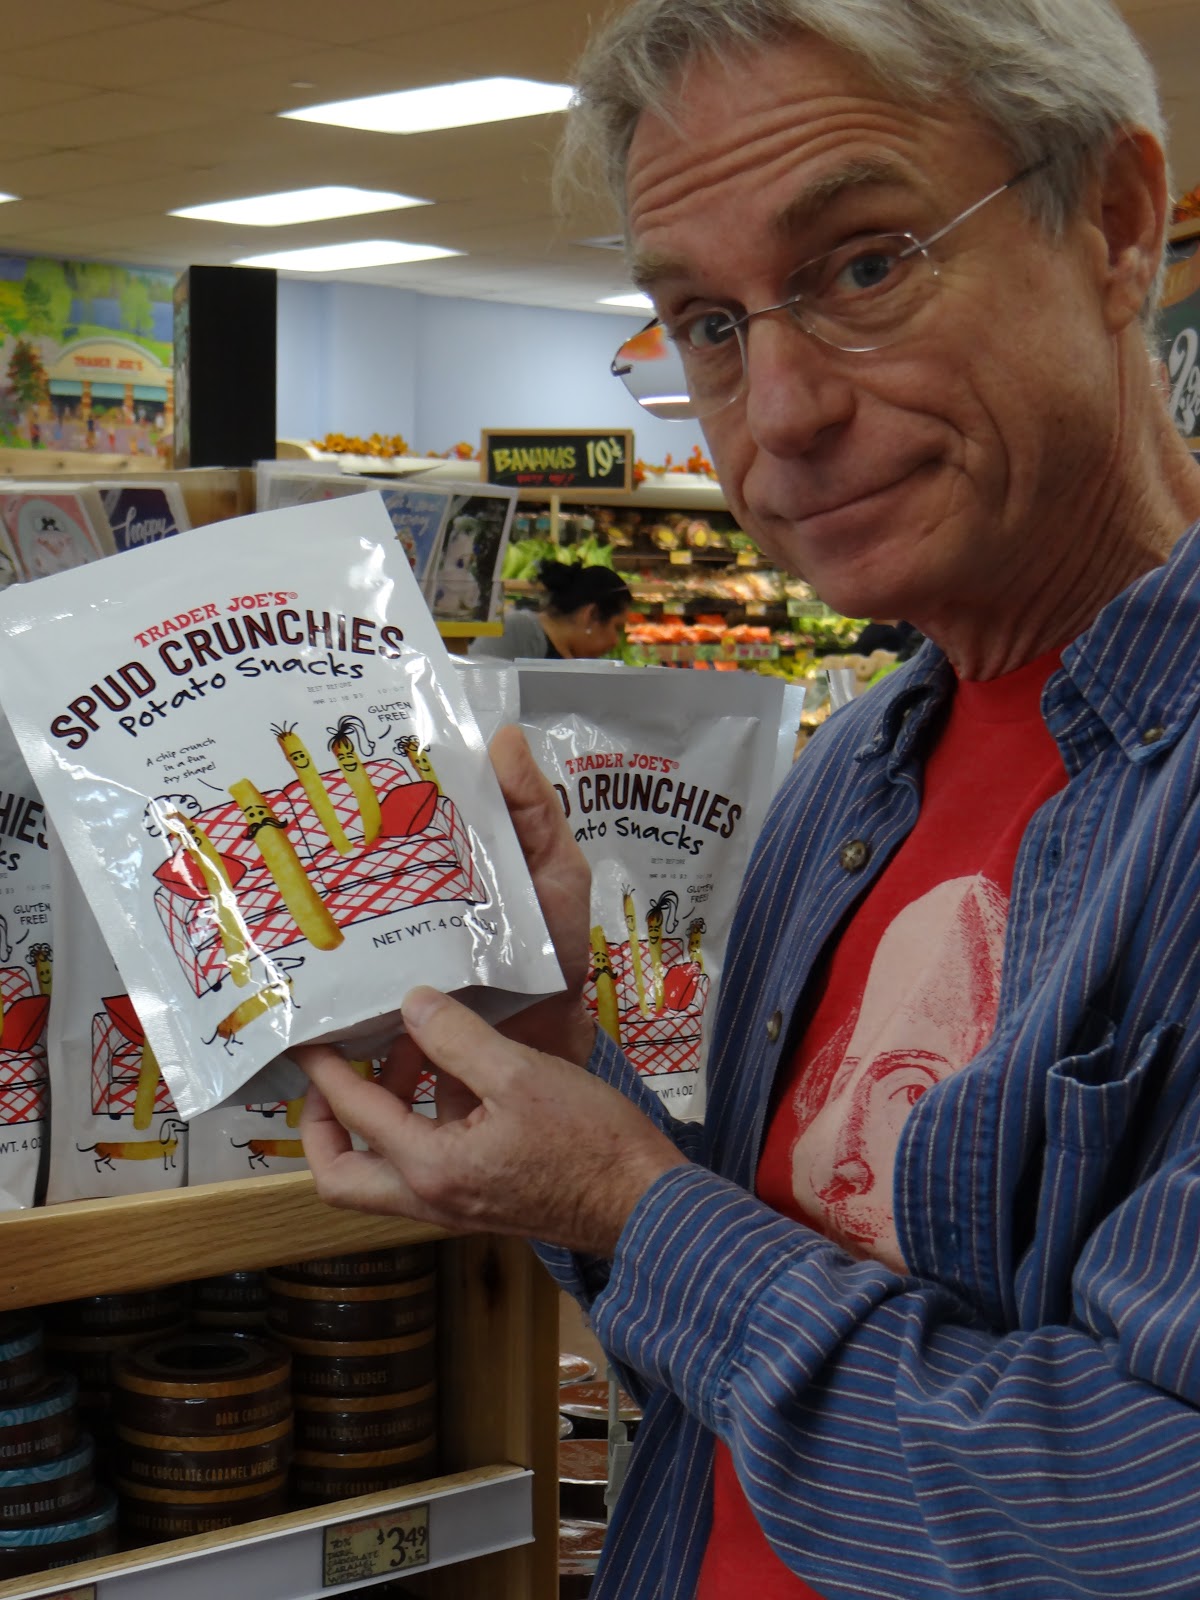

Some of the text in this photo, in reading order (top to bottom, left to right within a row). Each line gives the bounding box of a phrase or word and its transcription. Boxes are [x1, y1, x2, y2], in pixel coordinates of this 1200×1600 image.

[493, 446, 577, 472] BANANAS
[133, 603, 221, 648] TRADER
[236, 652, 364, 680] Snacks
[50, 609, 405, 750] SPUD CRUNCHIES
[368, 701, 413, 714] GLUTEN
[146, 737, 216, 767] A chip crunch
[163, 764, 174, 772] in
[187, 754, 206, 764] fun
[565, 753, 624, 775] TRADER
[163, 775, 181, 785] fry
[578, 773, 743, 839] CRUNCHIES
[614, 816, 704, 855] Snacks
[13, 902, 51, 914] GLUTEN
[372, 929, 402, 948] NET
[405, 919, 437, 937] WT.
[438, 917, 447, 929] 4
[681, 1084, 693, 1096] OZ
[21, 1139, 28, 1151] 4
[214, 1409, 240, 1427] DARK
[152, 1465, 202, 1482] CHOCOLATE
[205, 1465, 248, 1482] CARAMEL
[250, 1456, 279, 1477] WEDGES
